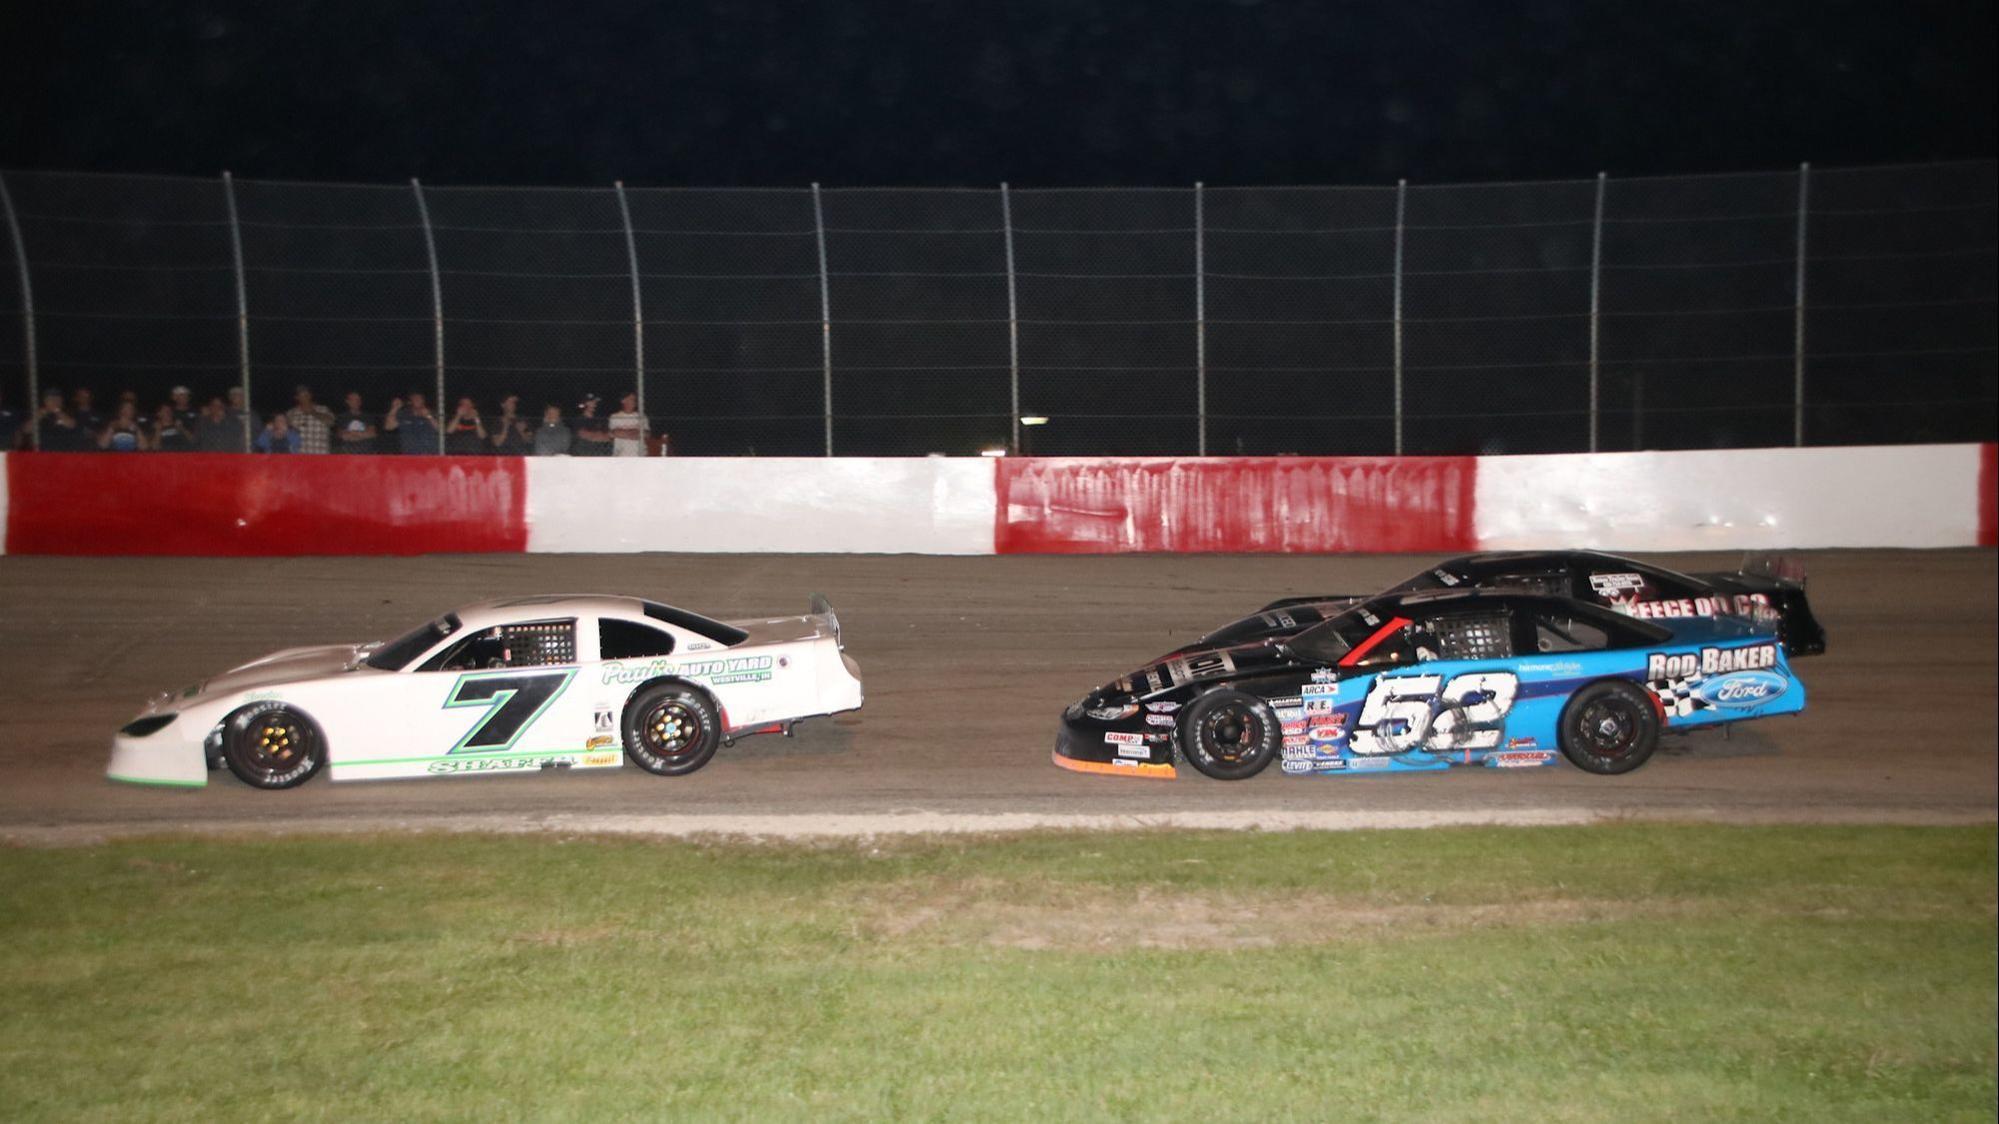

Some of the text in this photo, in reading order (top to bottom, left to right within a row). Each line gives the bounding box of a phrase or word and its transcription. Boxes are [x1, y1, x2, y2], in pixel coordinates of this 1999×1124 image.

[601, 655, 773, 685] Paul's AUTO YARD
[1647, 644, 1777, 681] ROD BAKER
[1303, 686, 1326, 695] ARCA
[1717, 677, 1768, 700] Ford
[445, 669, 577, 752] 7
[1349, 671, 1519, 754] 52
